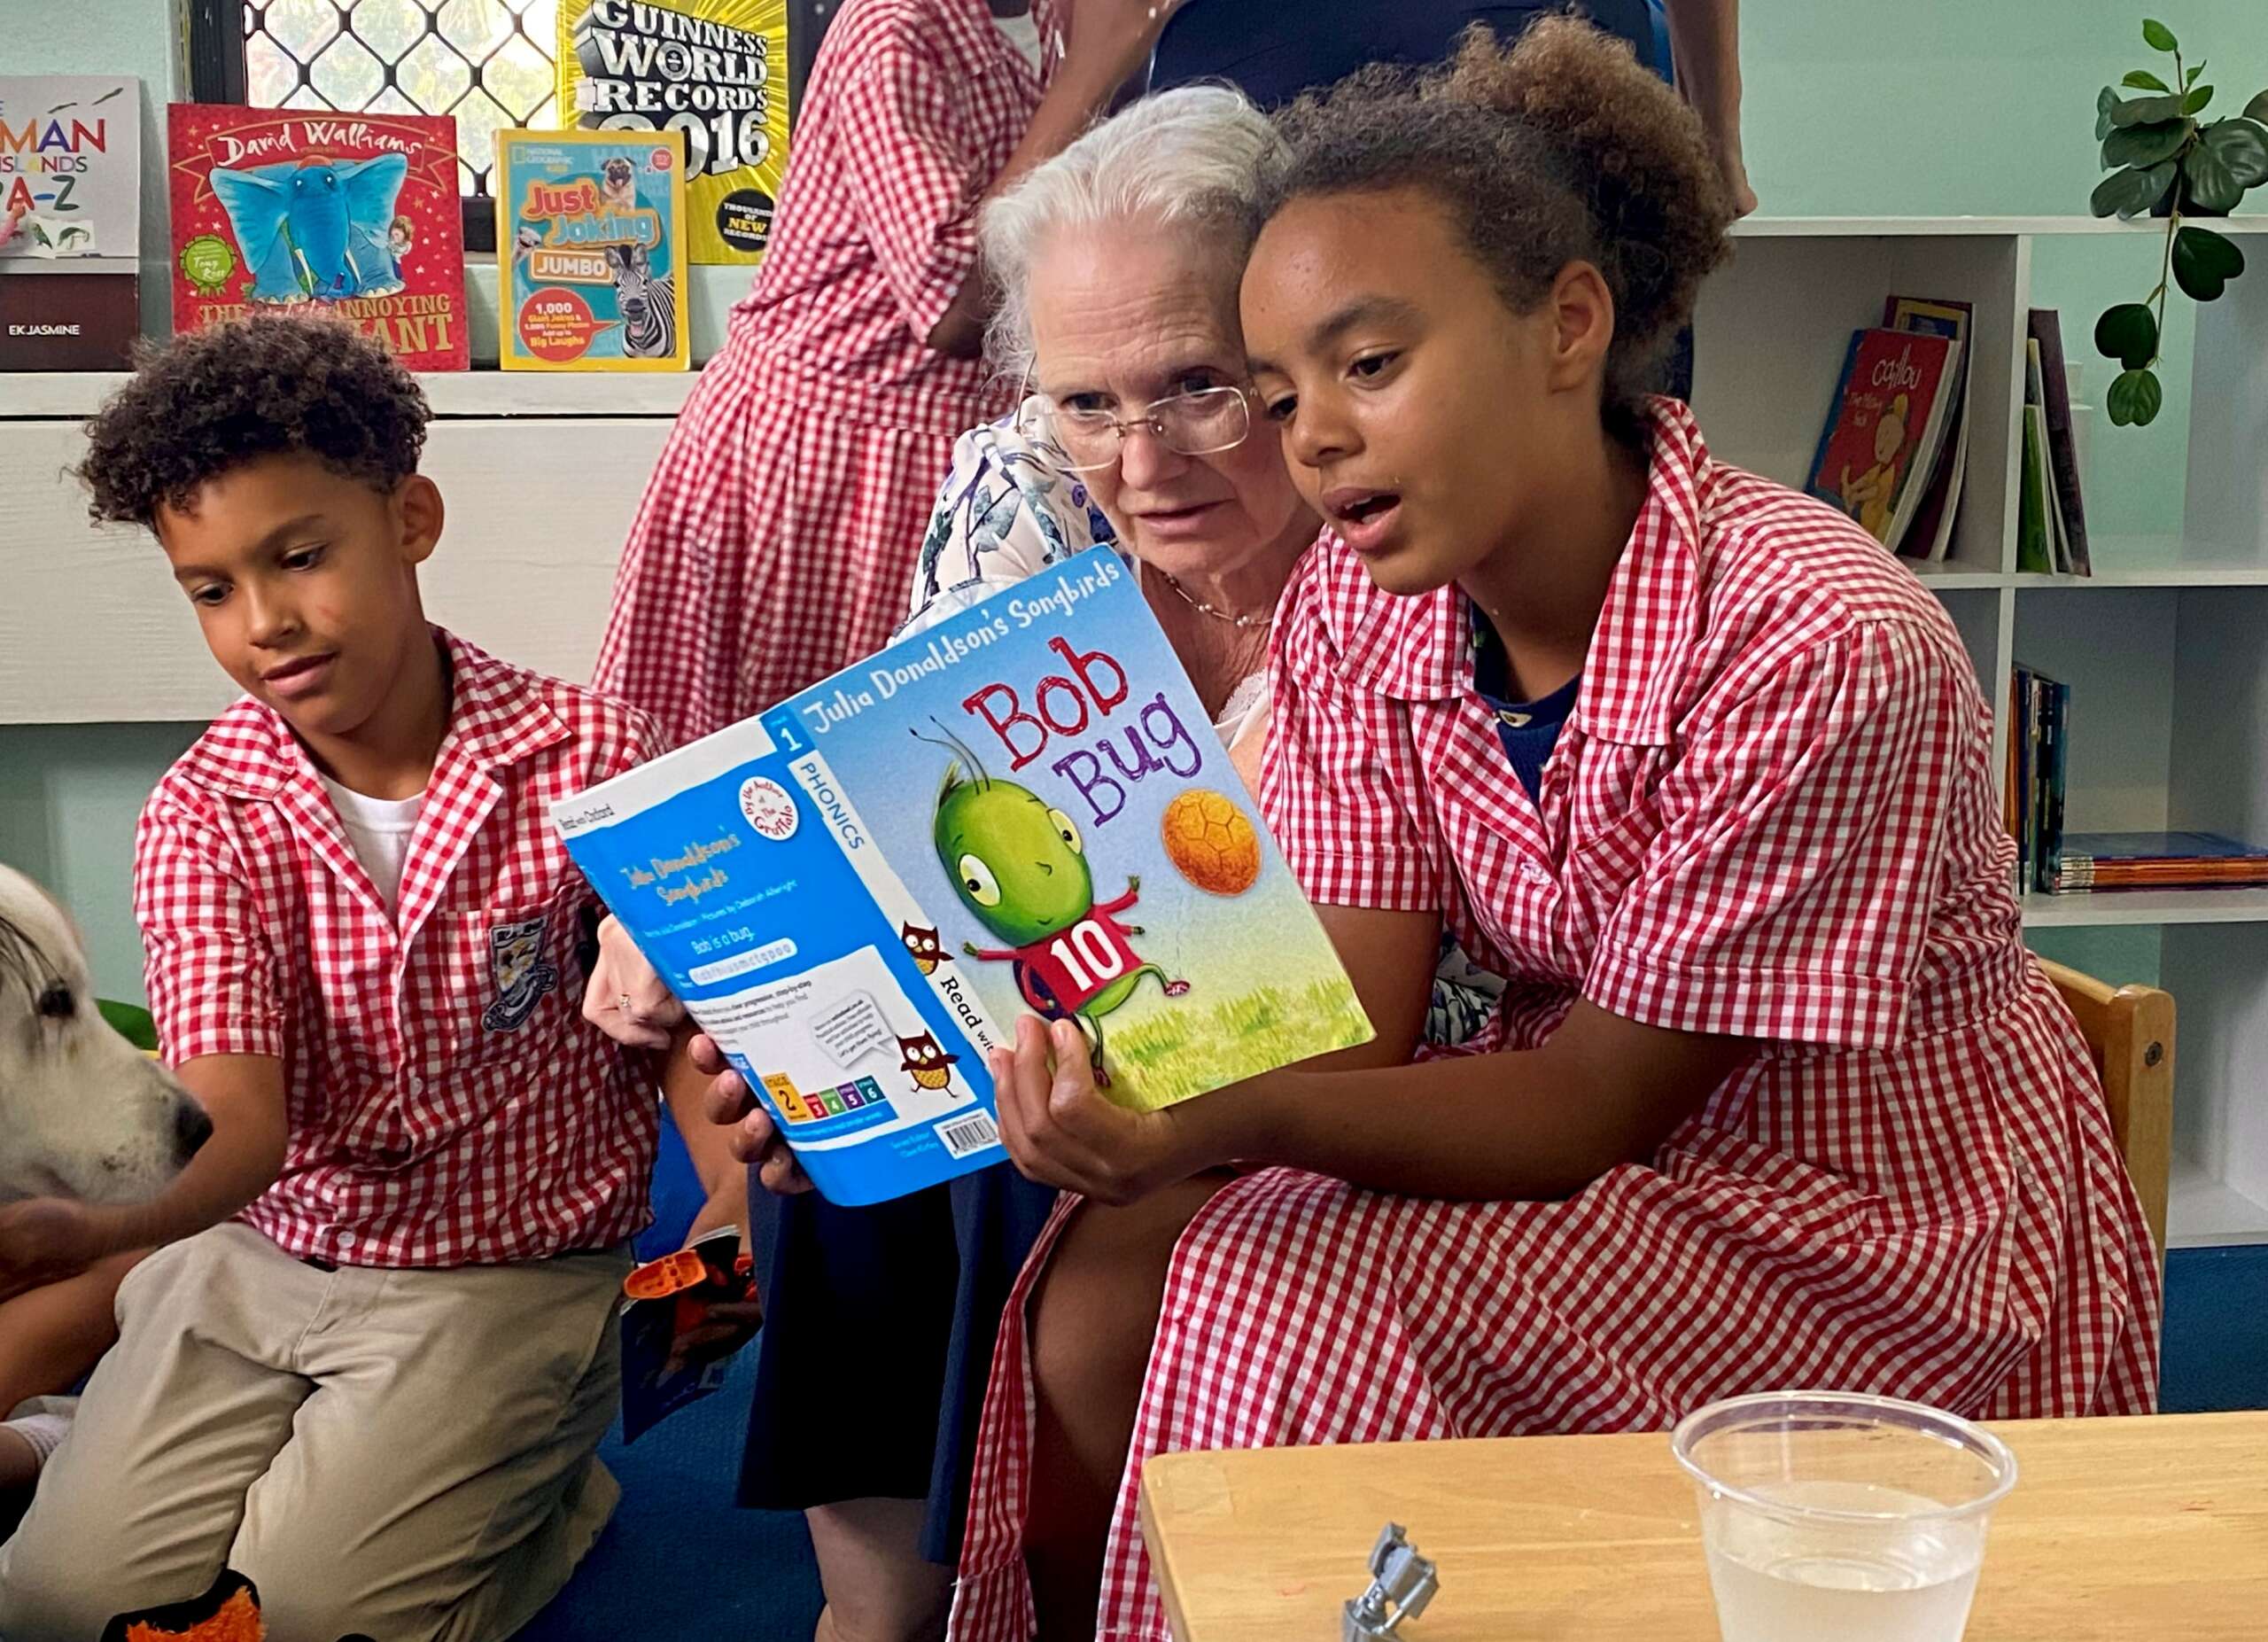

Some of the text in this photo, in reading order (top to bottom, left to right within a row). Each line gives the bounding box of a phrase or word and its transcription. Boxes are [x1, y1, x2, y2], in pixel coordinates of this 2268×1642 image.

[593, 0, 768, 58] GUINNESS
[592, 27, 769, 86] WORLD
[593, 78, 768, 112] RECORDS
[0, 118, 106, 153] MAN
[217, 121, 423, 167] David Walliams
[597, 111, 770, 183] 016
[526, 184, 594, 215] Just
[723, 202, 774, 217] THOUSAND
[552, 211, 654, 245] Joking
[728, 217, 767, 233] NEW
[536, 256, 607, 276] JUMBO
[337, 293, 451, 320] ANNOYING
[535, 302, 573, 315] 1,000
[9, 324, 81, 335] EK JASMINE
[530, 337, 548, 347] Big
[804, 560, 1120, 734] Julia Donaldson's Songbirds
[962, 636, 1129, 773] Bob
[781, 728, 803, 751] 1
[1052, 692, 1202, 828] Bug
[754, 804, 793, 836] Gruffalo
[800, 762, 865, 850] PHONICS
[723, 933, 732, 946] a
[1051, 919, 1124, 992] 10
[940, 976, 994, 1052] Read wit
[779, 1090, 797, 1111] 2
[831, 1101, 840, 1110] 4
[847, 1094, 858, 1106] 5
[866, 1087, 877, 1099] 6
[813, 1103, 823, 1117] 3
